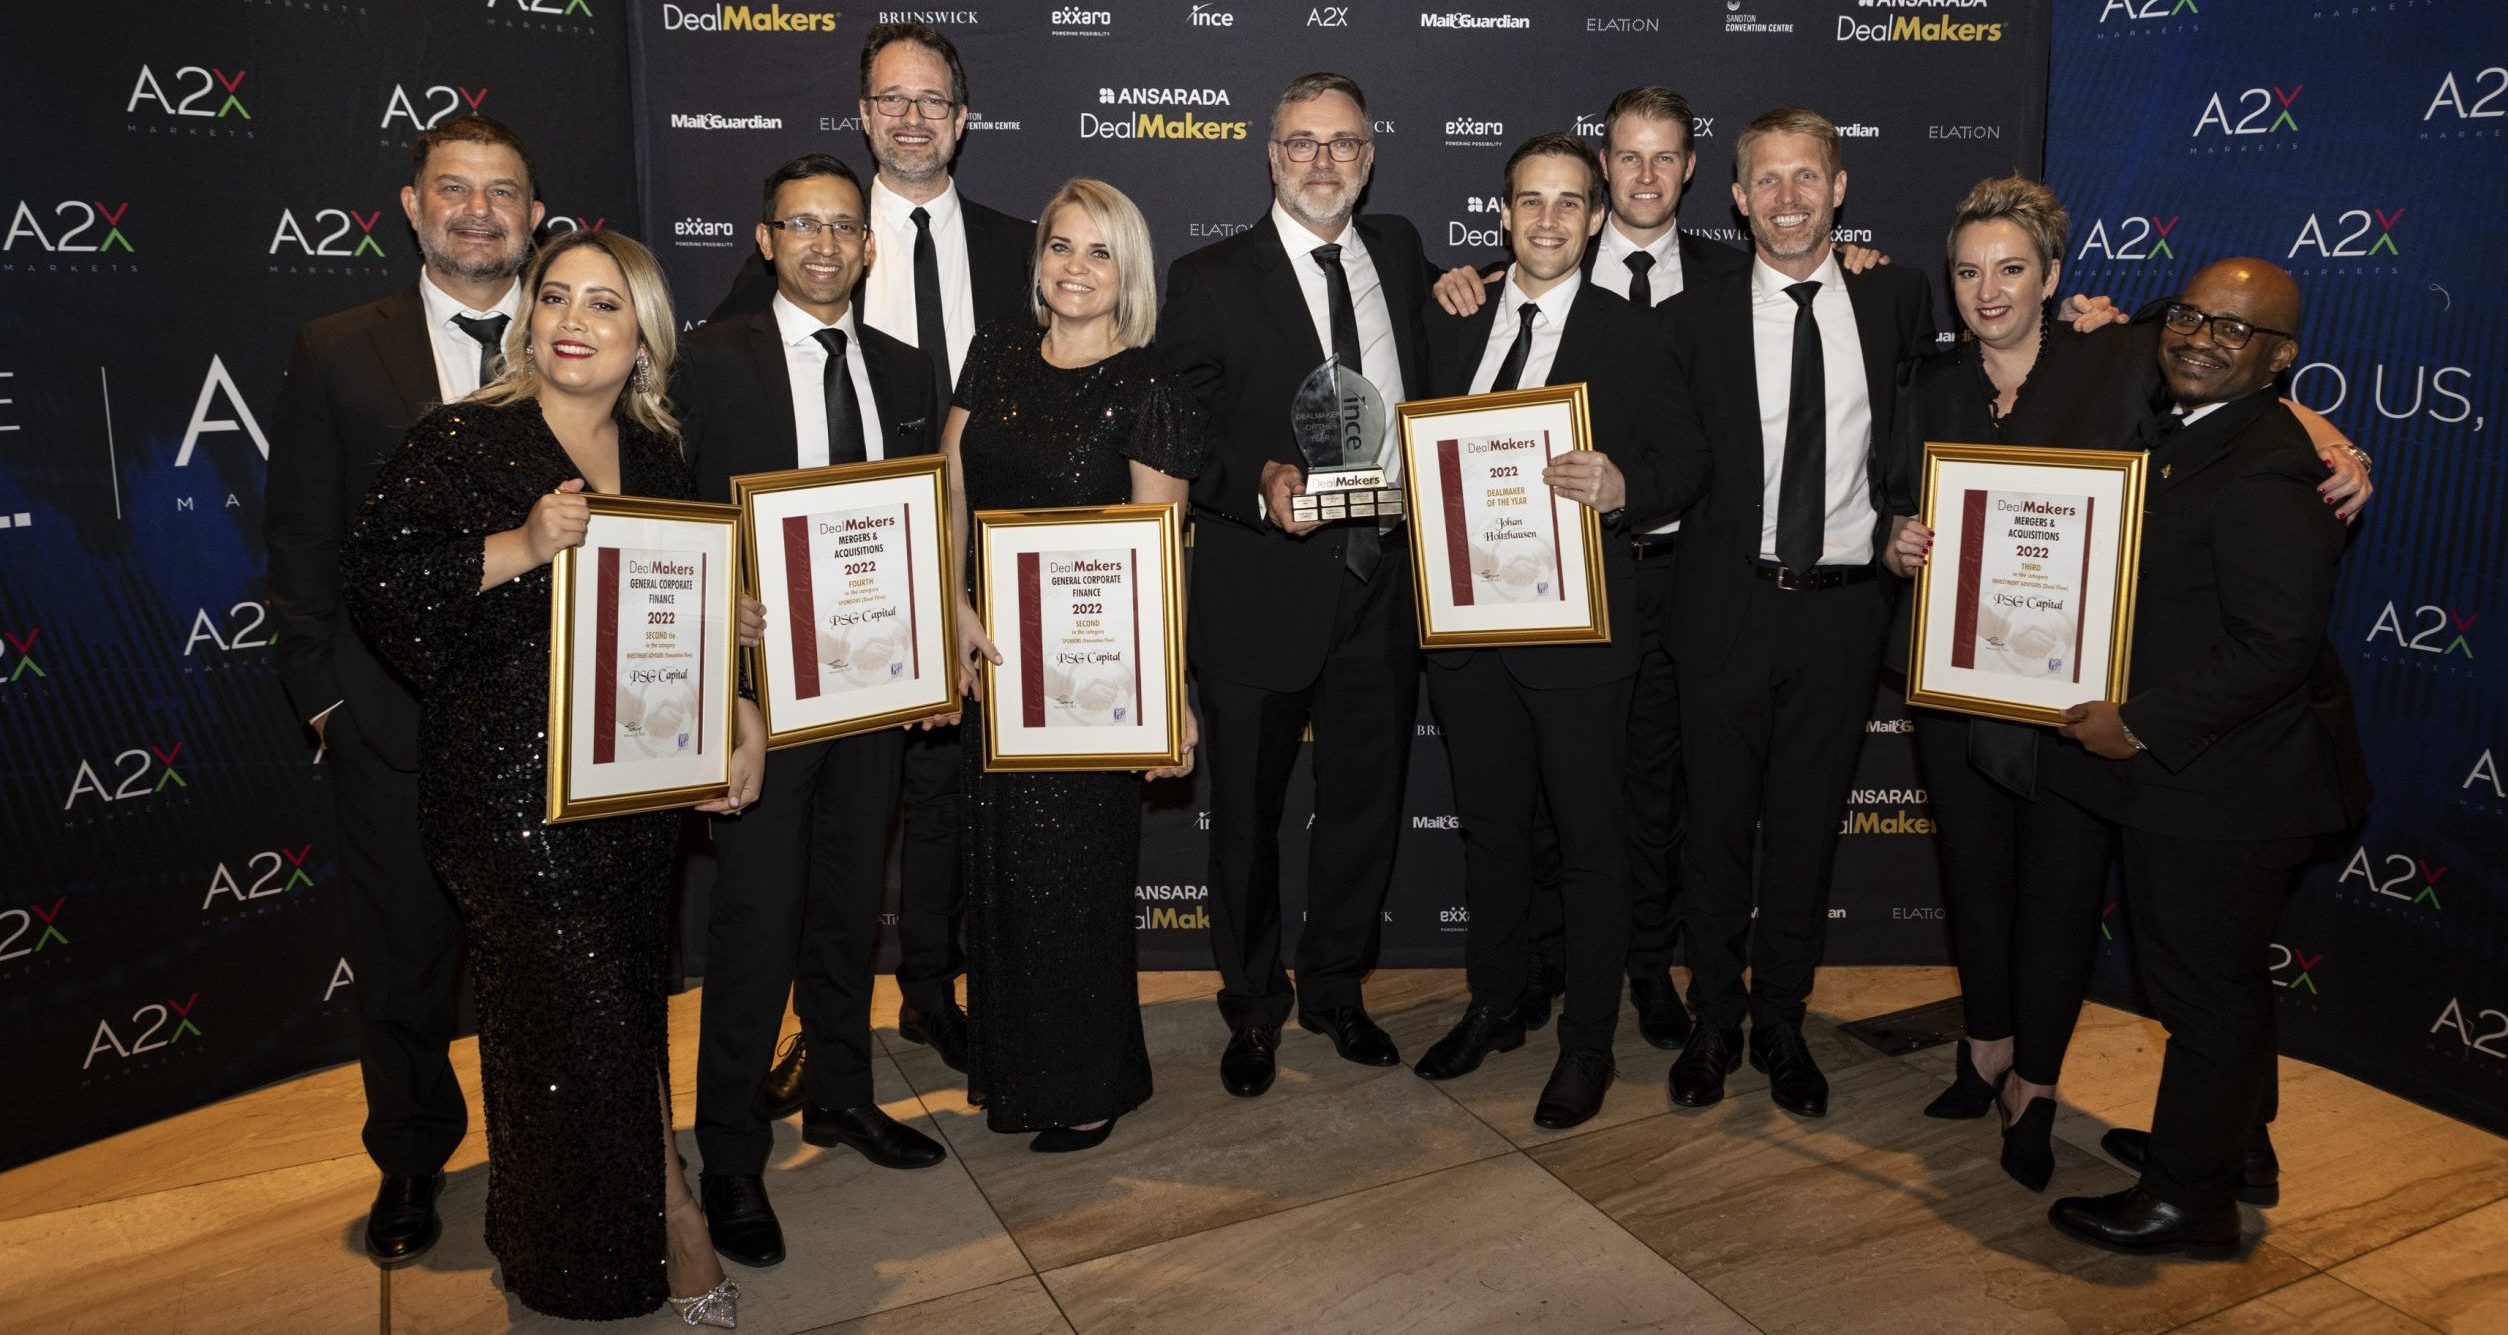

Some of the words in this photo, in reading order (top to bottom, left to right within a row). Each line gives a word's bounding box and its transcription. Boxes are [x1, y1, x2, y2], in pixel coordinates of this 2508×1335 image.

[664, 3, 837, 31] DealMakers
[879, 11, 979, 24] BRUNSWICK
[1052, 6, 1111, 25] exxaro
[1190, 4, 1234, 26] ince
[1307, 7, 1348, 26] A2X
[1726, 14, 1757, 23] SANDTON
[1725, 23, 1767, 32] CONVENTION
[1768, 24, 1794, 33] CENTRE
[1837, 14, 2002, 41] DealMakers
[127, 63, 252, 119] A2X
[1118, 88, 1230, 105] ANSARADA
[2424, 67, 2508, 121] A2
[2193, 84, 2303, 137] A2X
[995, 121, 1021, 130] CENTRE
[1080, 111, 1247, 140] DealMakers
[1446, 117, 1503, 135] exxaro
[1573, 113, 1604, 136] inc
[1693, 117, 1714, 137] 2X
[3, 200, 135, 252] A2X
[269, 208, 385, 257] A2X
[675, 218, 733, 236] exxaro
[1830, 225, 1872, 242] xxaro
[2287, 207, 2404, 259] A2X
[2077, 215, 2179, 260] A2X
[2375, 364, 2485, 432] US,
[1468, 438, 1536, 453] DealMakers
[1490, 466, 1518, 478] 2022
[1487, 487, 1526, 497] DEALMAKER
[1497, 498, 1509, 506] THE
[1512, 497, 1528, 505] YEAR
[1998, 500, 2076, 516] DealMakers
[820, 516, 895, 535] DealMakers
[1496, 517, 1523, 531] Johan
[2014, 516, 2048, 527] MERGERS
[2050, 519, 2055, 527] &
[838, 532, 871, 545] MERGERS
[872, 532, 878, 541] &
[2008, 529, 2060, 541] ACQUISITIONS
[834, 544, 884, 559] ACQUISITIONS
[2016, 545, 2049, 558] 2022
[630, 560, 694, 575] DealMakers
[844, 561, 876, 575] 2022
[1050, 559, 1122, 573] DealMakers
[2021, 563, 2041, 571] THIRD
[630, 578, 657, 589] GENERAL
[659, 579, 693, 590] CORPORATE
[849, 578, 874, 588] FOURTH
[1052, 576, 1081, 585] GENERAL
[1083, 575, 1121, 584] CORPORATE
[649, 594, 675, 604] FINANCE
[1072, 588, 1101, 597] FINANCE
[1072, 603, 1102, 614] 2022
[1994, 593, 2024, 607] PSG
[2027, 597, 2064, 611] Capital
[648, 611, 675, 624] 2022
[829, 612, 860, 628] PSG
[862, 606, 896, 622] Capital
[645, 631, 667, 640] SECOND
[2366, 600, 2480, 660] A2X
[1056, 652, 1085, 666] PSG
[1087, 651, 1121, 665] Capital
[630, 669, 657, 685] PSG
[658, 668, 689, 684] Capital
[64, 742, 187, 810] A2X
[202, 843, 315, 910] A2X
[2338, 846, 2447, 911] A2X
[1135, 885, 1208, 900] ANSARA
[0, 897, 70, 962] 2X
[2269, 944, 2324, 994] 2X
[83, 992, 203, 1070] A2X
[2430, 998, 2508, 1059] A2
